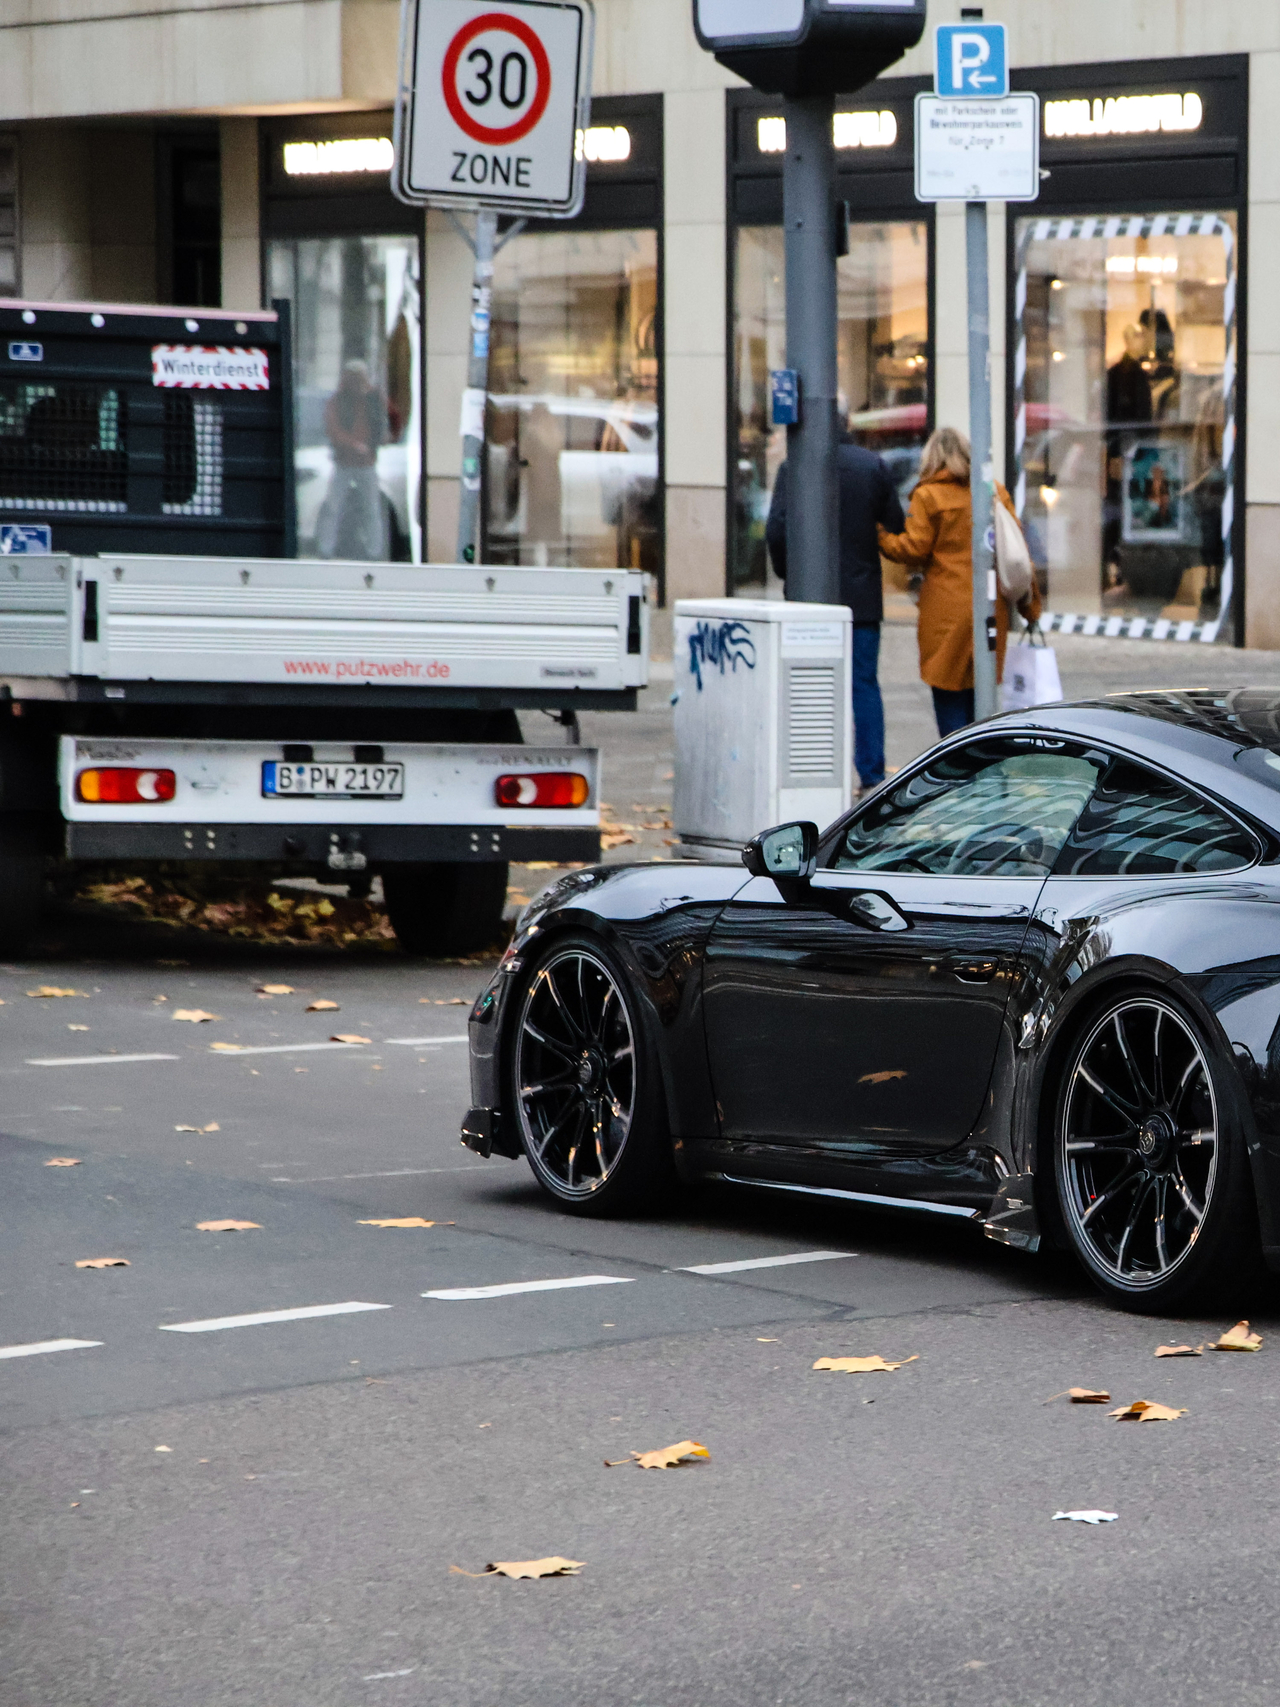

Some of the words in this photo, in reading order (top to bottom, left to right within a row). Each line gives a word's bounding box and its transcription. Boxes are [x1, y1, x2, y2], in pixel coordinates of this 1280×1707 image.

[952, 33, 990, 89] P
[465, 48, 527, 109] 30
[451, 151, 532, 188] ZONE
[162, 358, 259, 378] Winterdienst
[284, 660, 450, 679] www.putzwehr.de
[279, 767, 292, 789] B
[310, 767, 338, 789] PW
[345, 768, 399, 790] 2197
